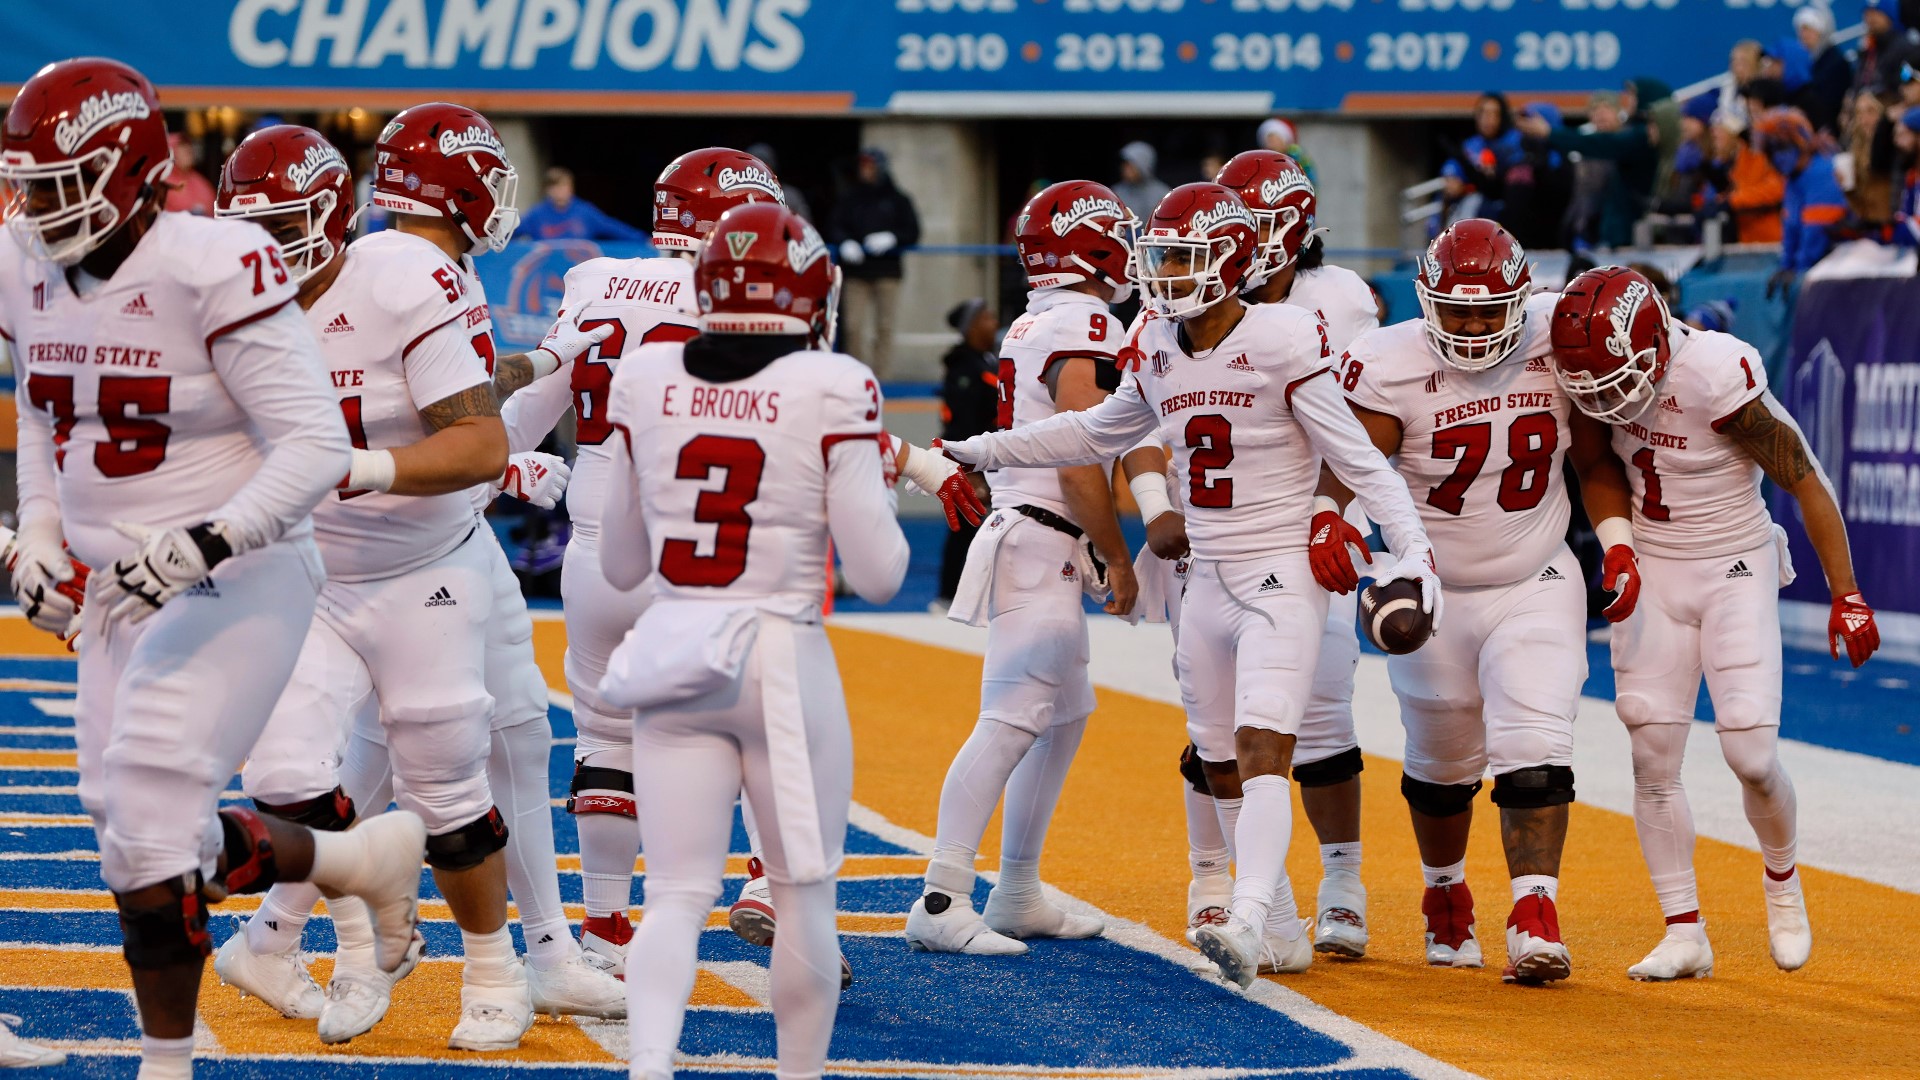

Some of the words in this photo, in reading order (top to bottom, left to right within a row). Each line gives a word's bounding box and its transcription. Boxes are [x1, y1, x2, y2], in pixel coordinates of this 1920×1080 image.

[229, 0, 805, 71] CHAMPIONS
[896, 33, 1008, 71] 2010
[1053, 33, 1165, 71] 2012
[1210, 33, 1321, 71] 2014
[1366, 33, 1469, 70] 2017
[1514, 33, 1620, 70] 2019
[54, 89, 150, 156] Bulldogs
[1051, 196, 1124, 238] Bulldogs
[725, 231, 759, 261] V
[240, 245, 288, 296] 75
[733, 266, 745, 284] 3
[604, 276, 681, 305] SPOMER
[323, 324, 355, 334] adidas
[1088, 313, 1107, 342] 9
[1317, 324, 1331, 359] 2
[29, 343, 87, 364] FRESNO
[94, 346, 162, 368] STATE
[1226, 362, 1255, 371] adidas
[1525, 365, 1551, 373] adidas
[1739, 355, 1757, 391] 1
[662, 385, 680, 417] E.
[690, 386, 780, 423] BROOKS
[864, 379, 879, 422] 3
[1161, 390, 1206, 417] FRESNO
[1208, 391, 1256, 409] STATE
[1434, 396, 1502, 429] FRESNO
[1507, 393, 1553, 409] STATE
[27, 372, 172, 479] 75
[1650, 431, 1688, 450] STATE
[1184, 413, 1235, 508] 2
[1425, 410, 1559, 516] 78
[1631, 446, 1671, 522] 1
[659, 433, 766, 588] 3
[1257, 583, 1284, 593] adidas
[1538, 574, 1566, 582] adidas
[1725, 570, 1753, 579] adidas
[424, 598, 457, 608] adidas
